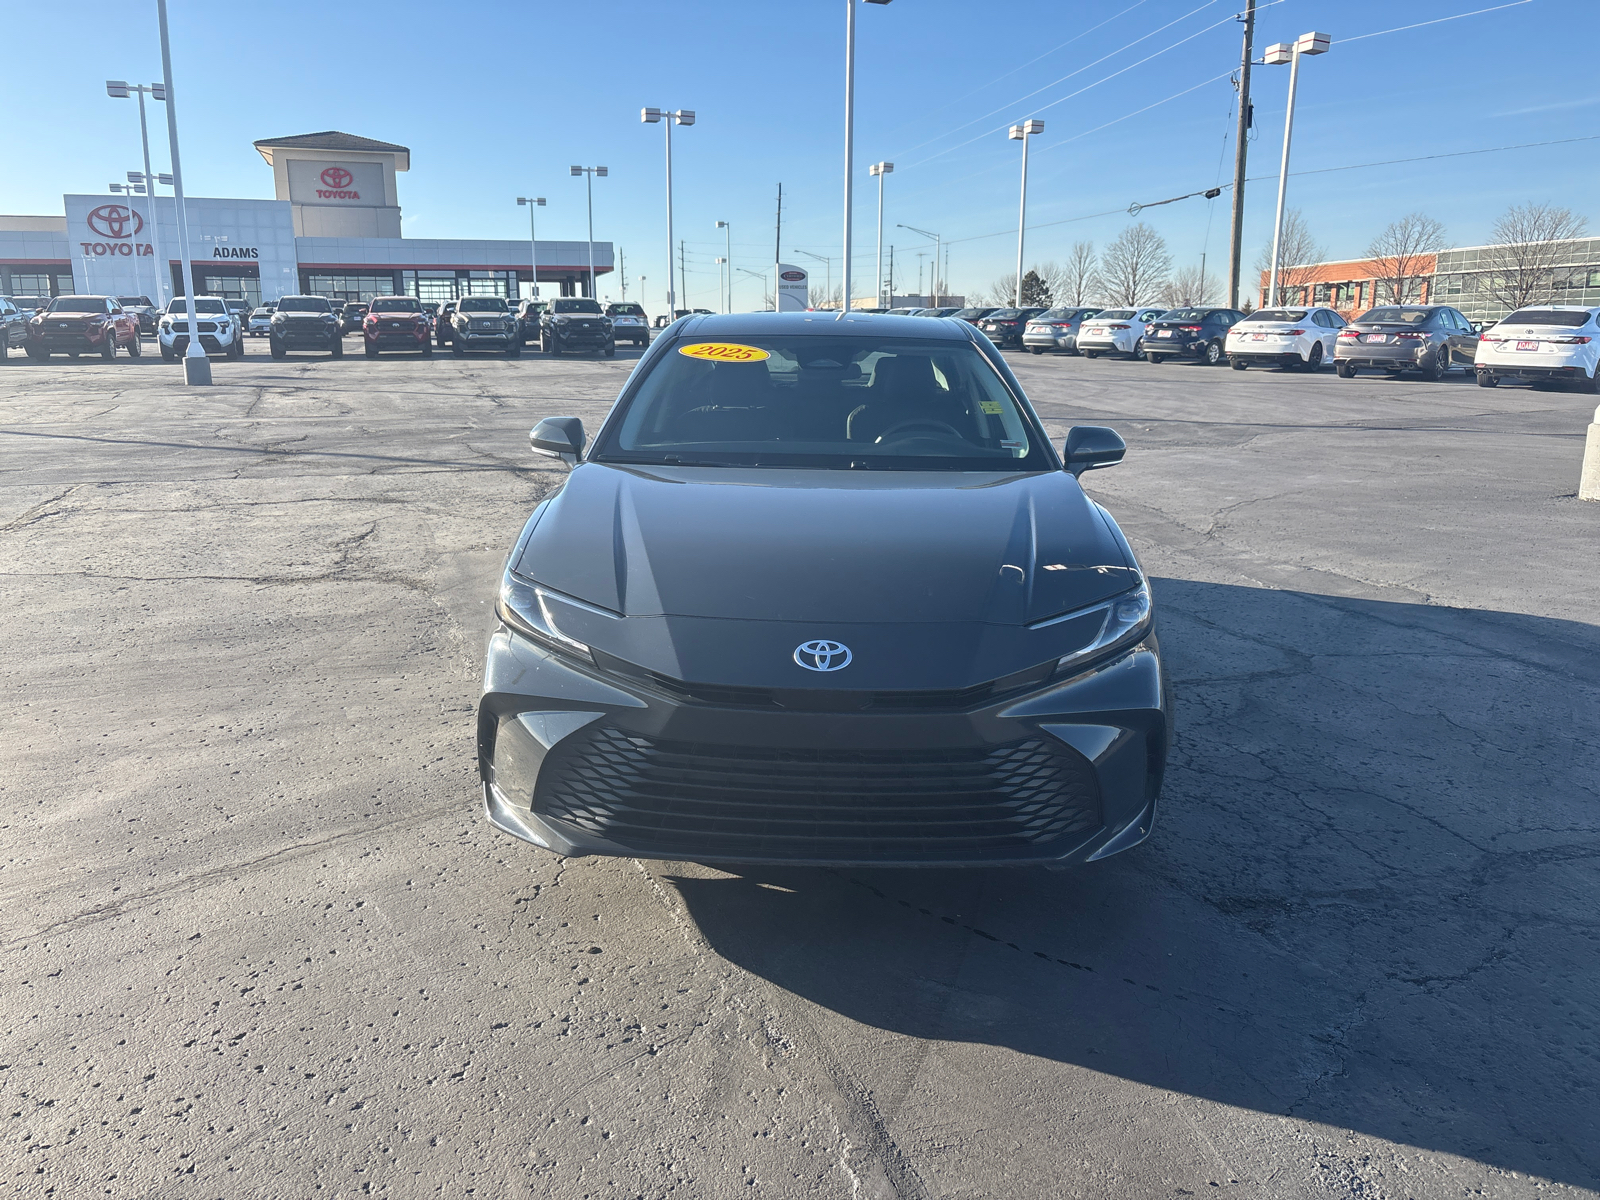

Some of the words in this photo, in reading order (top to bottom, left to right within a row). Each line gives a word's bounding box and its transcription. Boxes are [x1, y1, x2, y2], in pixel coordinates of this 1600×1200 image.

[315, 189, 360, 199] TOYOTA
[80, 242, 154, 256] TOYOTA
[213, 247, 258, 258] ADAMS
[1517, 341, 1537, 350] ADAMS
[691, 346, 758, 359] 2025
